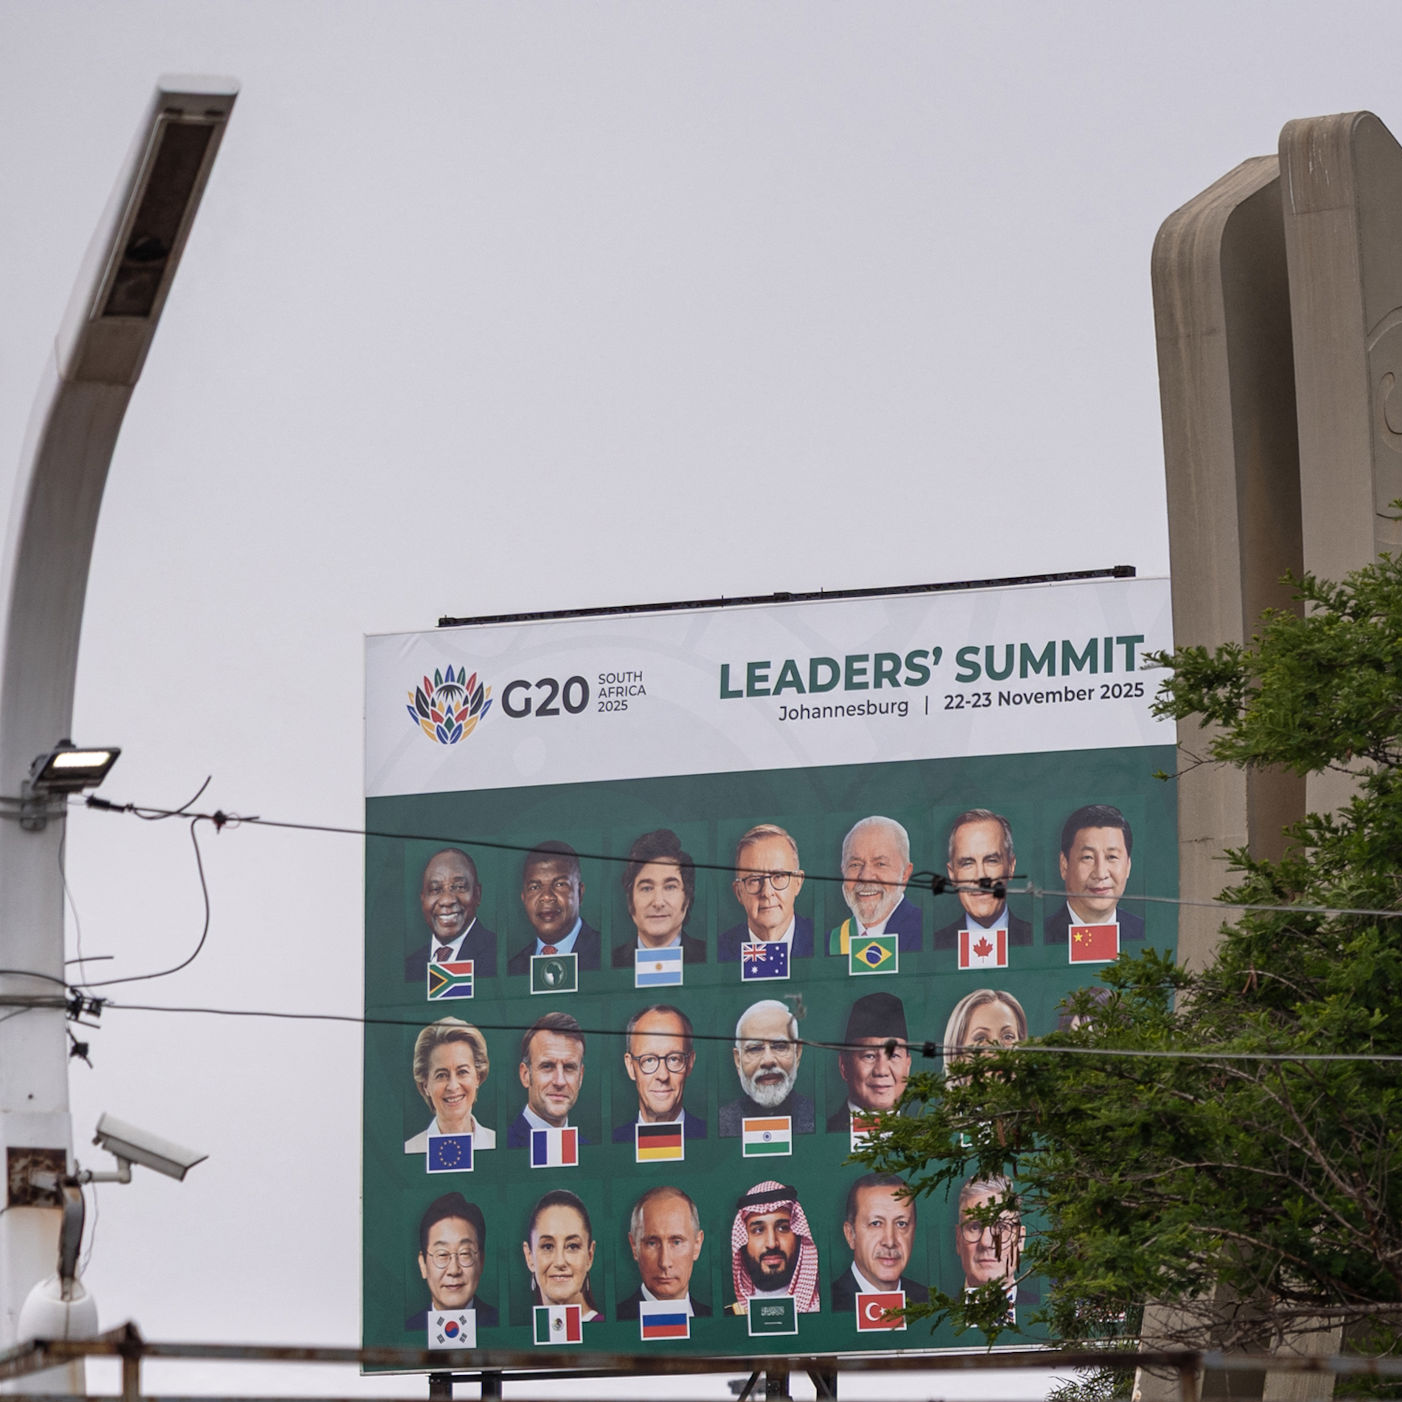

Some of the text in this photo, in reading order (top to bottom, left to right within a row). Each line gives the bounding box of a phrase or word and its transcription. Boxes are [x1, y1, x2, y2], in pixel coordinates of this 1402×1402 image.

[598, 671, 643, 685] SOUTH
[720, 634, 1145, 699] LEADERS’ SUMMIT
[501, 675, 590, 718] G20
[598, 685, 647, 698] AFRICA
[778, 699, 909, 721] Johannesburg
[944, 692, 992, 710] 22-23
[998, 686, 1095, 707] November
[1099, 682, 1145, 700] 2025
[598, 700, 628, 712] 2025
